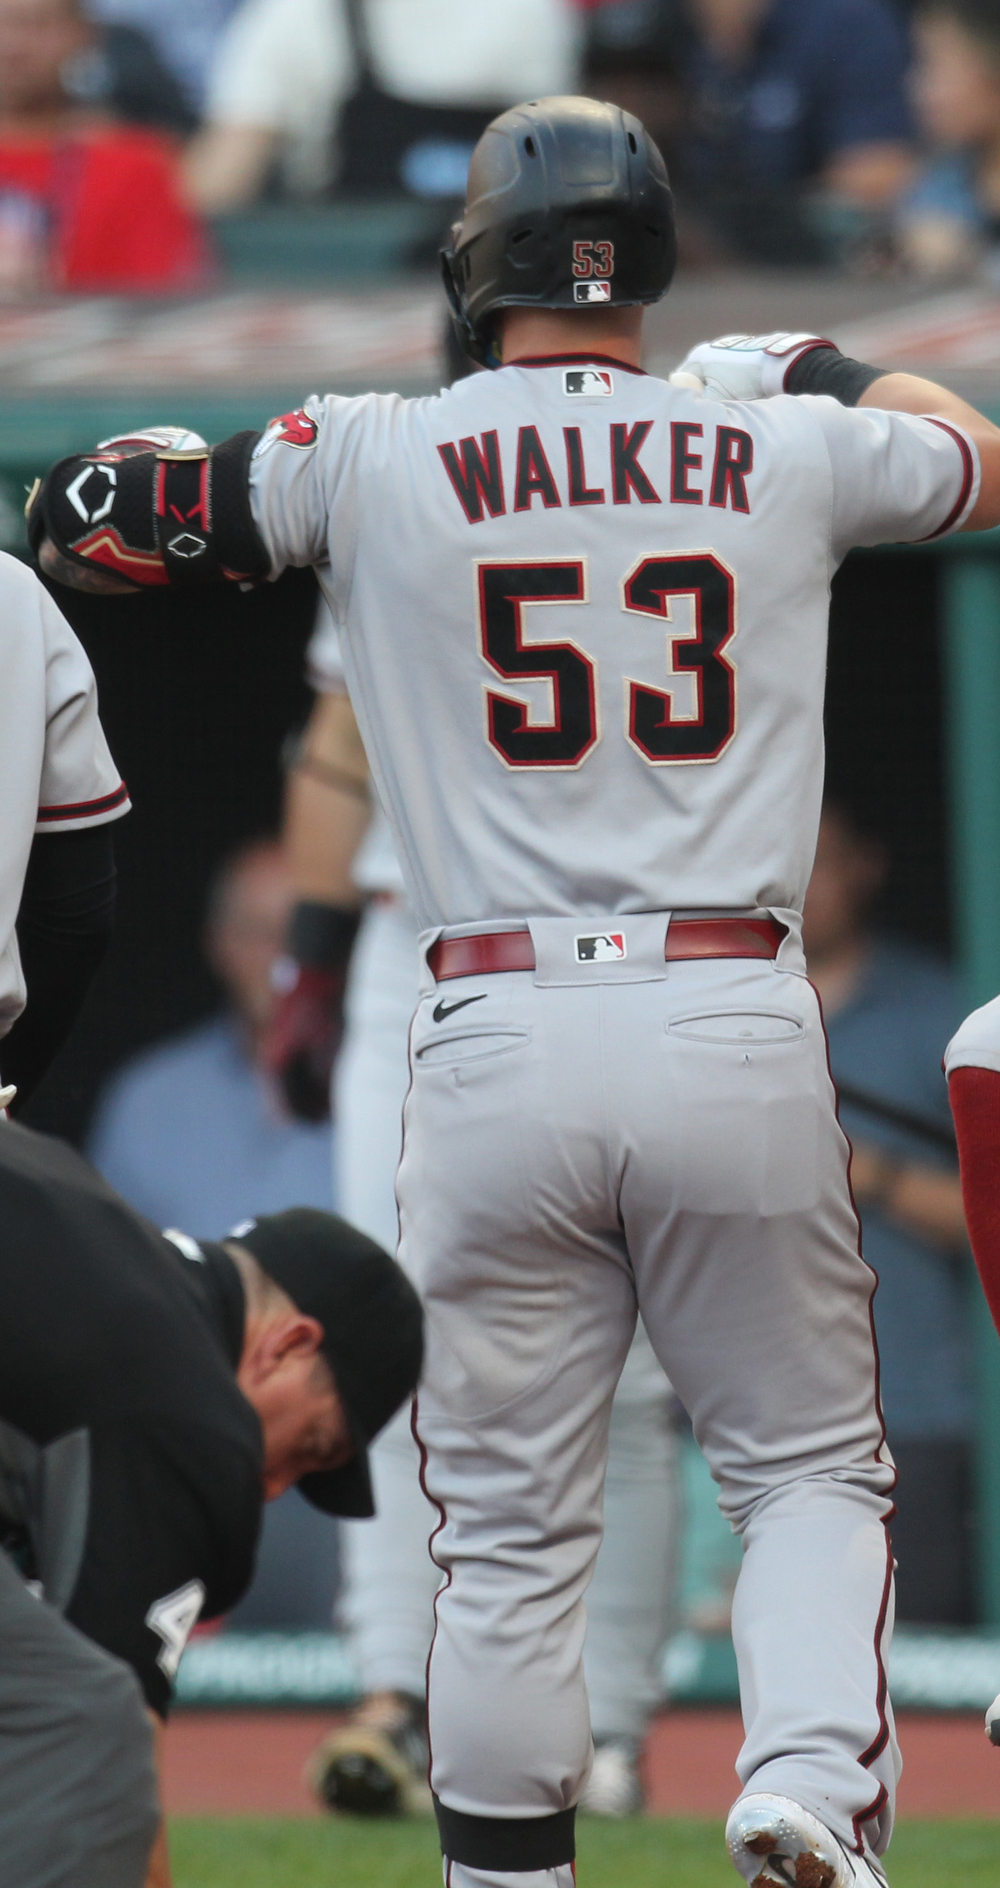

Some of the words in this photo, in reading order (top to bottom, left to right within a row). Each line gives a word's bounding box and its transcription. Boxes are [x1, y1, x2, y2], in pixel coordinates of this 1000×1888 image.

[572, 240, 615, 278] 53
[436, 420, 754, 525] WALKER
[472, 547, 740, 772] 53
